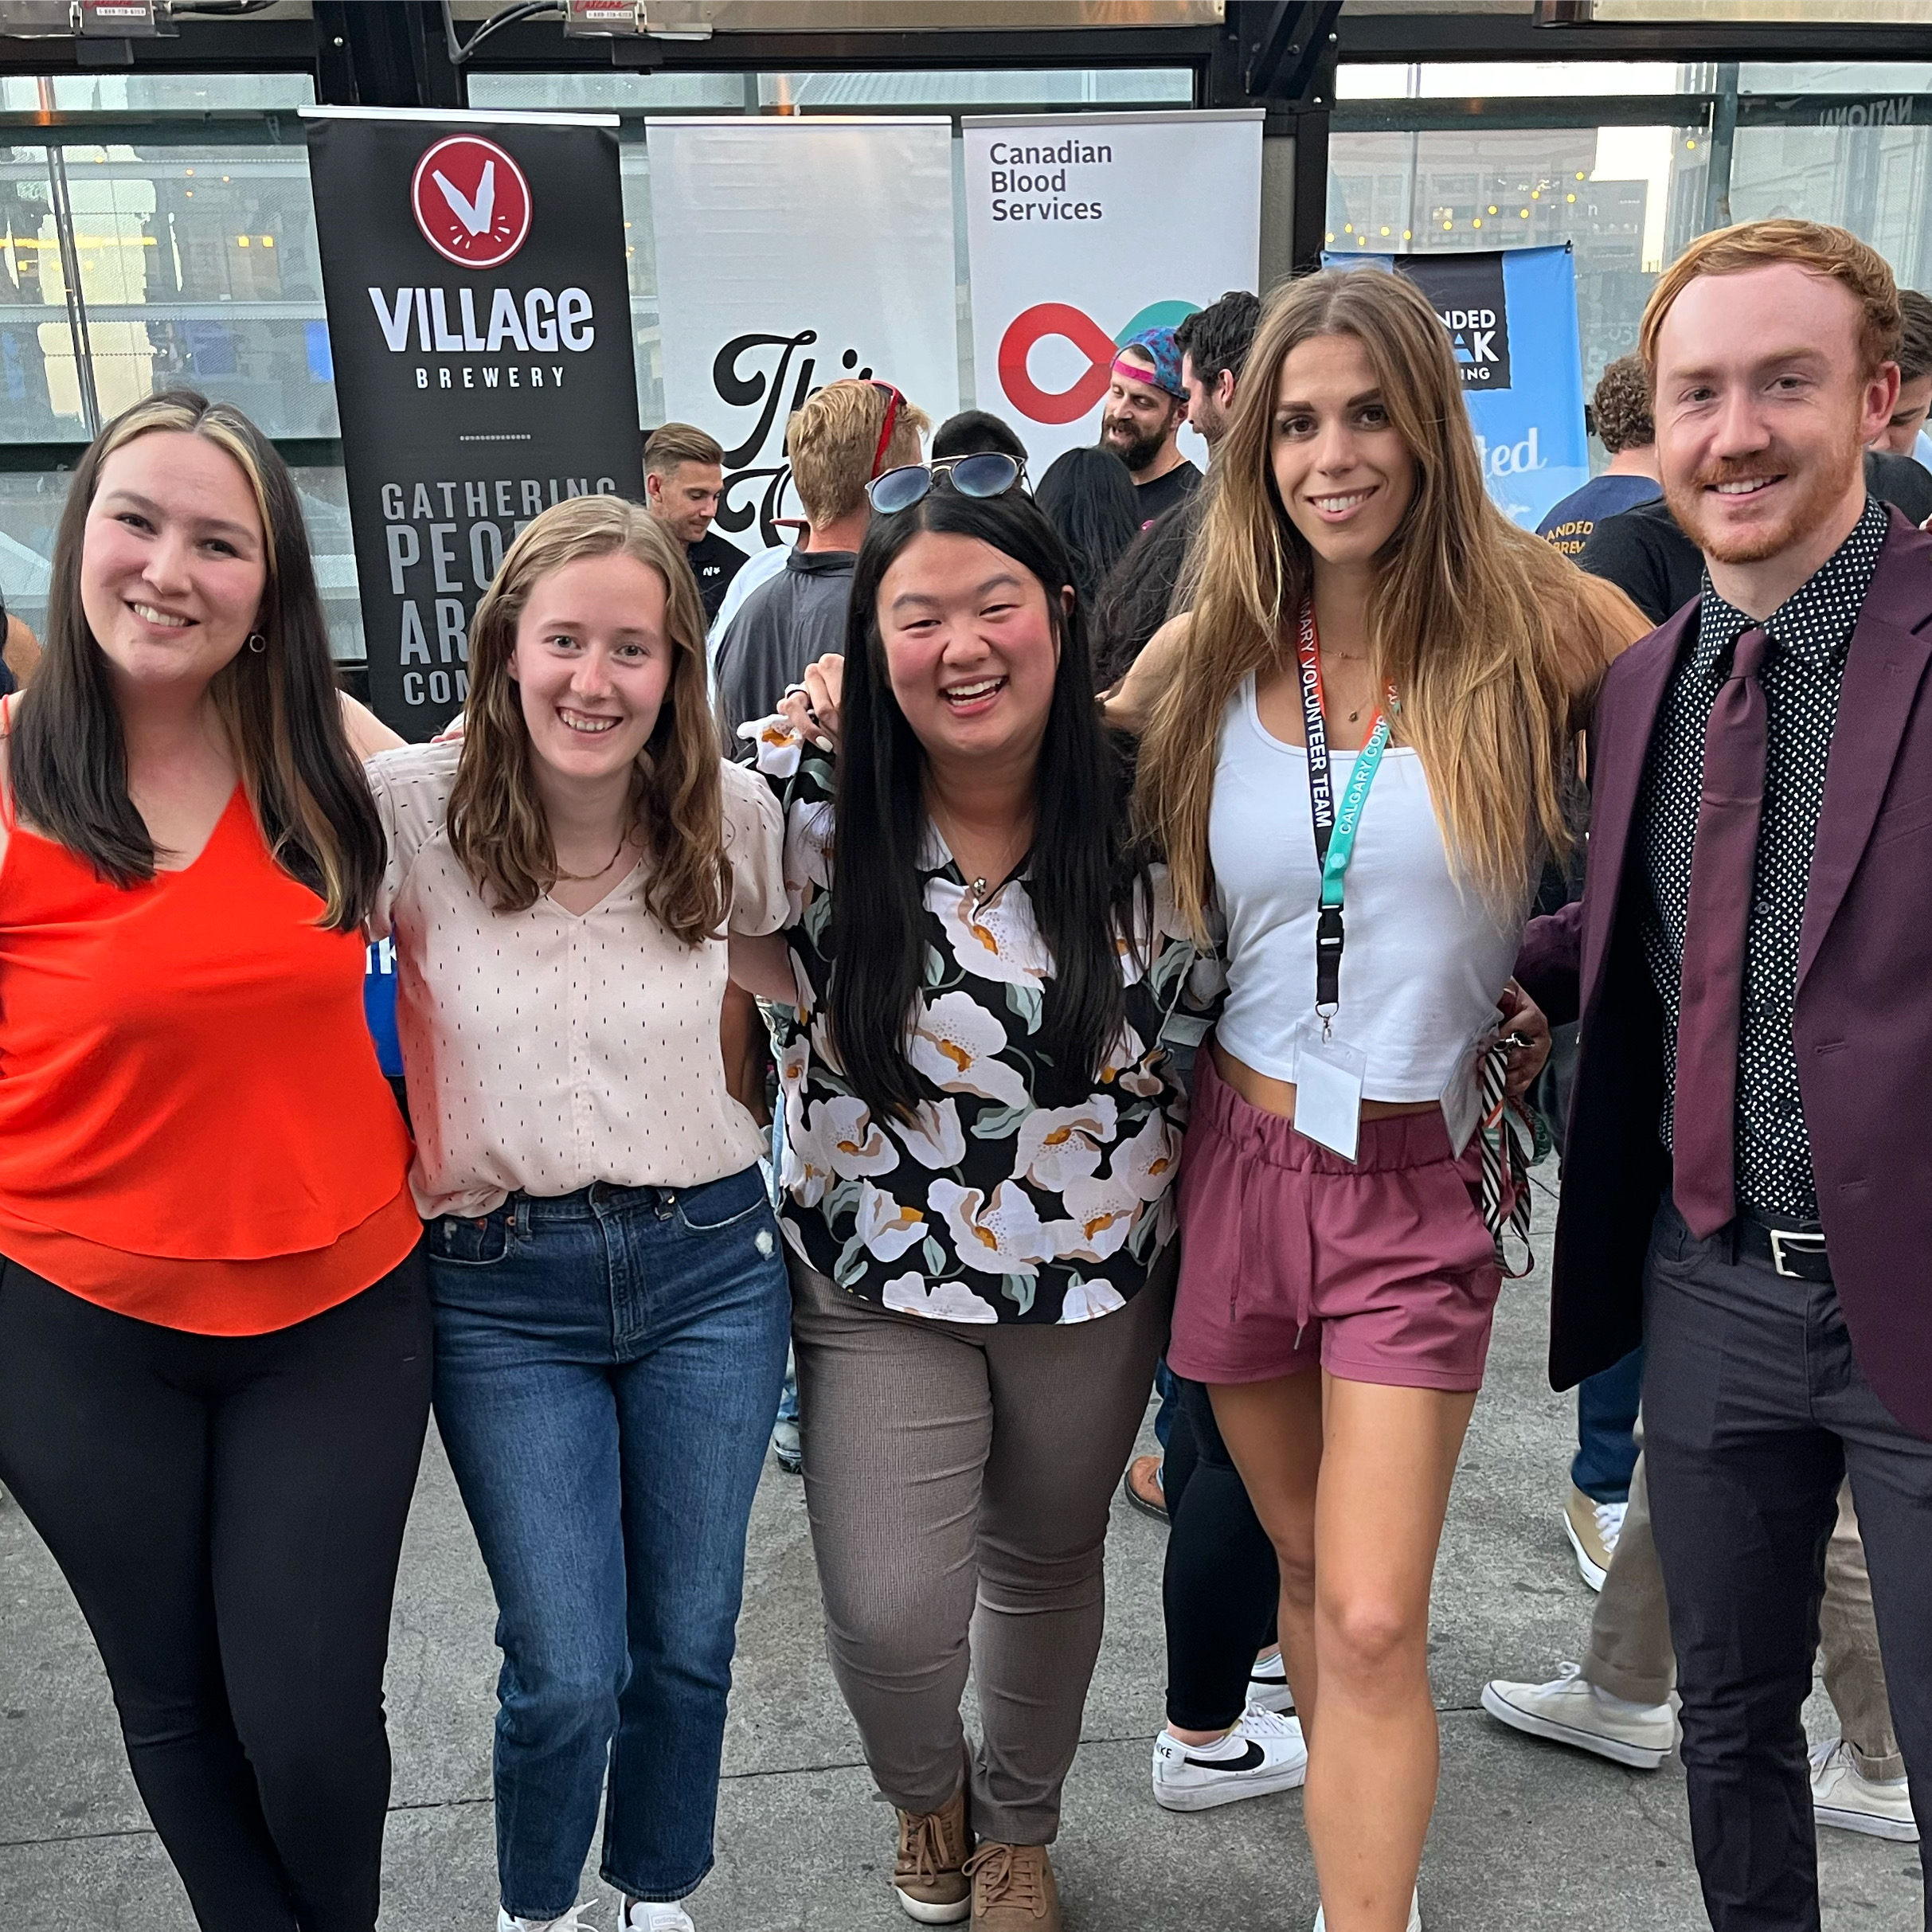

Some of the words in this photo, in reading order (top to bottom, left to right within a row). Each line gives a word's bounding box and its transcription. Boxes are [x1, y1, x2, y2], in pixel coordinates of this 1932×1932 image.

[990, 140, 1113, 165] Canadian
[991, 169, 1066, 193] Blood
[992, 197, 1102, 221] Services
[1437, 309, 1496, 330] NDED
[416, 366, 563, 389] BREWERY
[1542, 521, 1594, 542] ANDED
[1301, 657, 1327, 771] VOLUNTEER
[1312, 773, 1332, 828] TEAM
[1339, 760, 1373, 835] CALGARY
